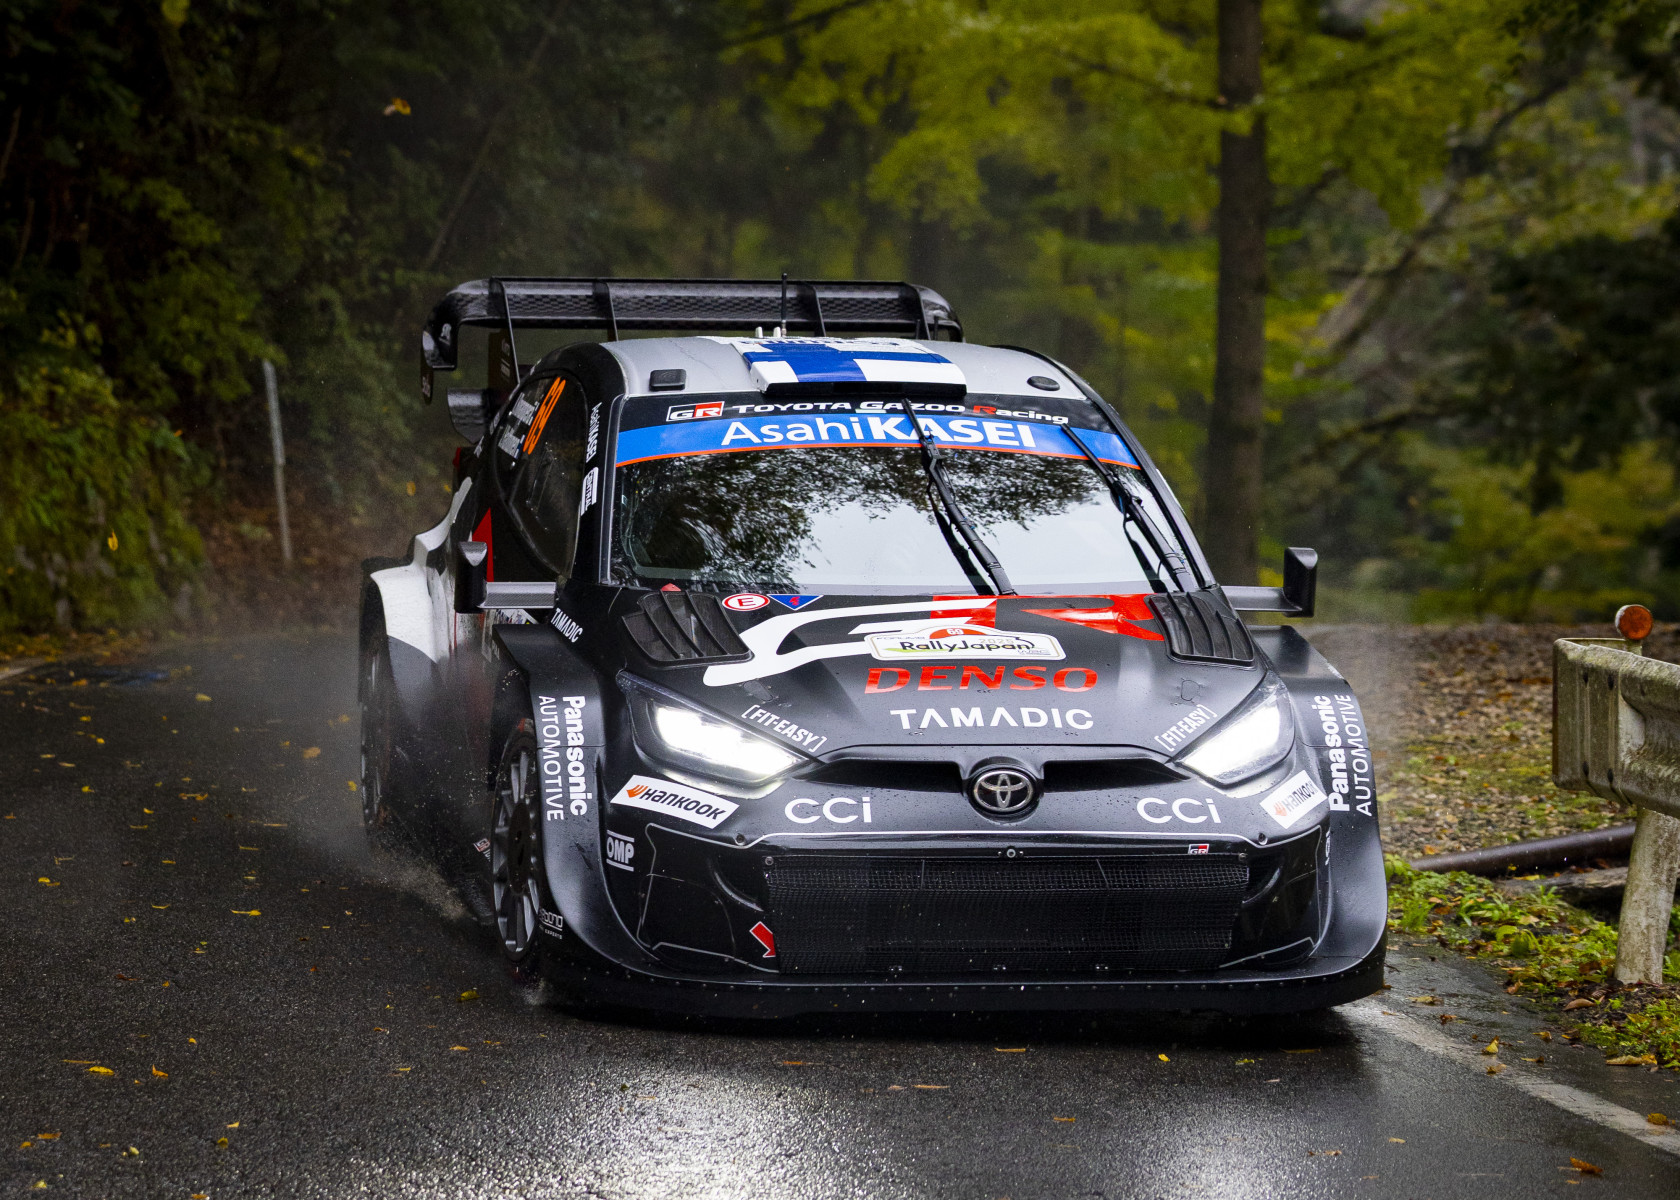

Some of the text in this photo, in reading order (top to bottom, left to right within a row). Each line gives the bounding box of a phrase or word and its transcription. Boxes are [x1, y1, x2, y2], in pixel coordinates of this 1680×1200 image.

[669, 403, 723, 420] GR
[732, 401, 1068, 424] TOYOTA GAZOO Racing
[550, 607, 583, 643] TAMADIC
[864, 665, 1098, 694] DENSO
[890, 706, 1094, 731] TAMADIC
[538, 695, 564, 821] AUTOMOTIVE
[562, 695, 593, 816] Panasonic
[1312, 695, 1351, 812] Panasonic
[1334, 694, 1373, 817] AUTOMOTIVE
[606, 836, 635, 865] OMP
